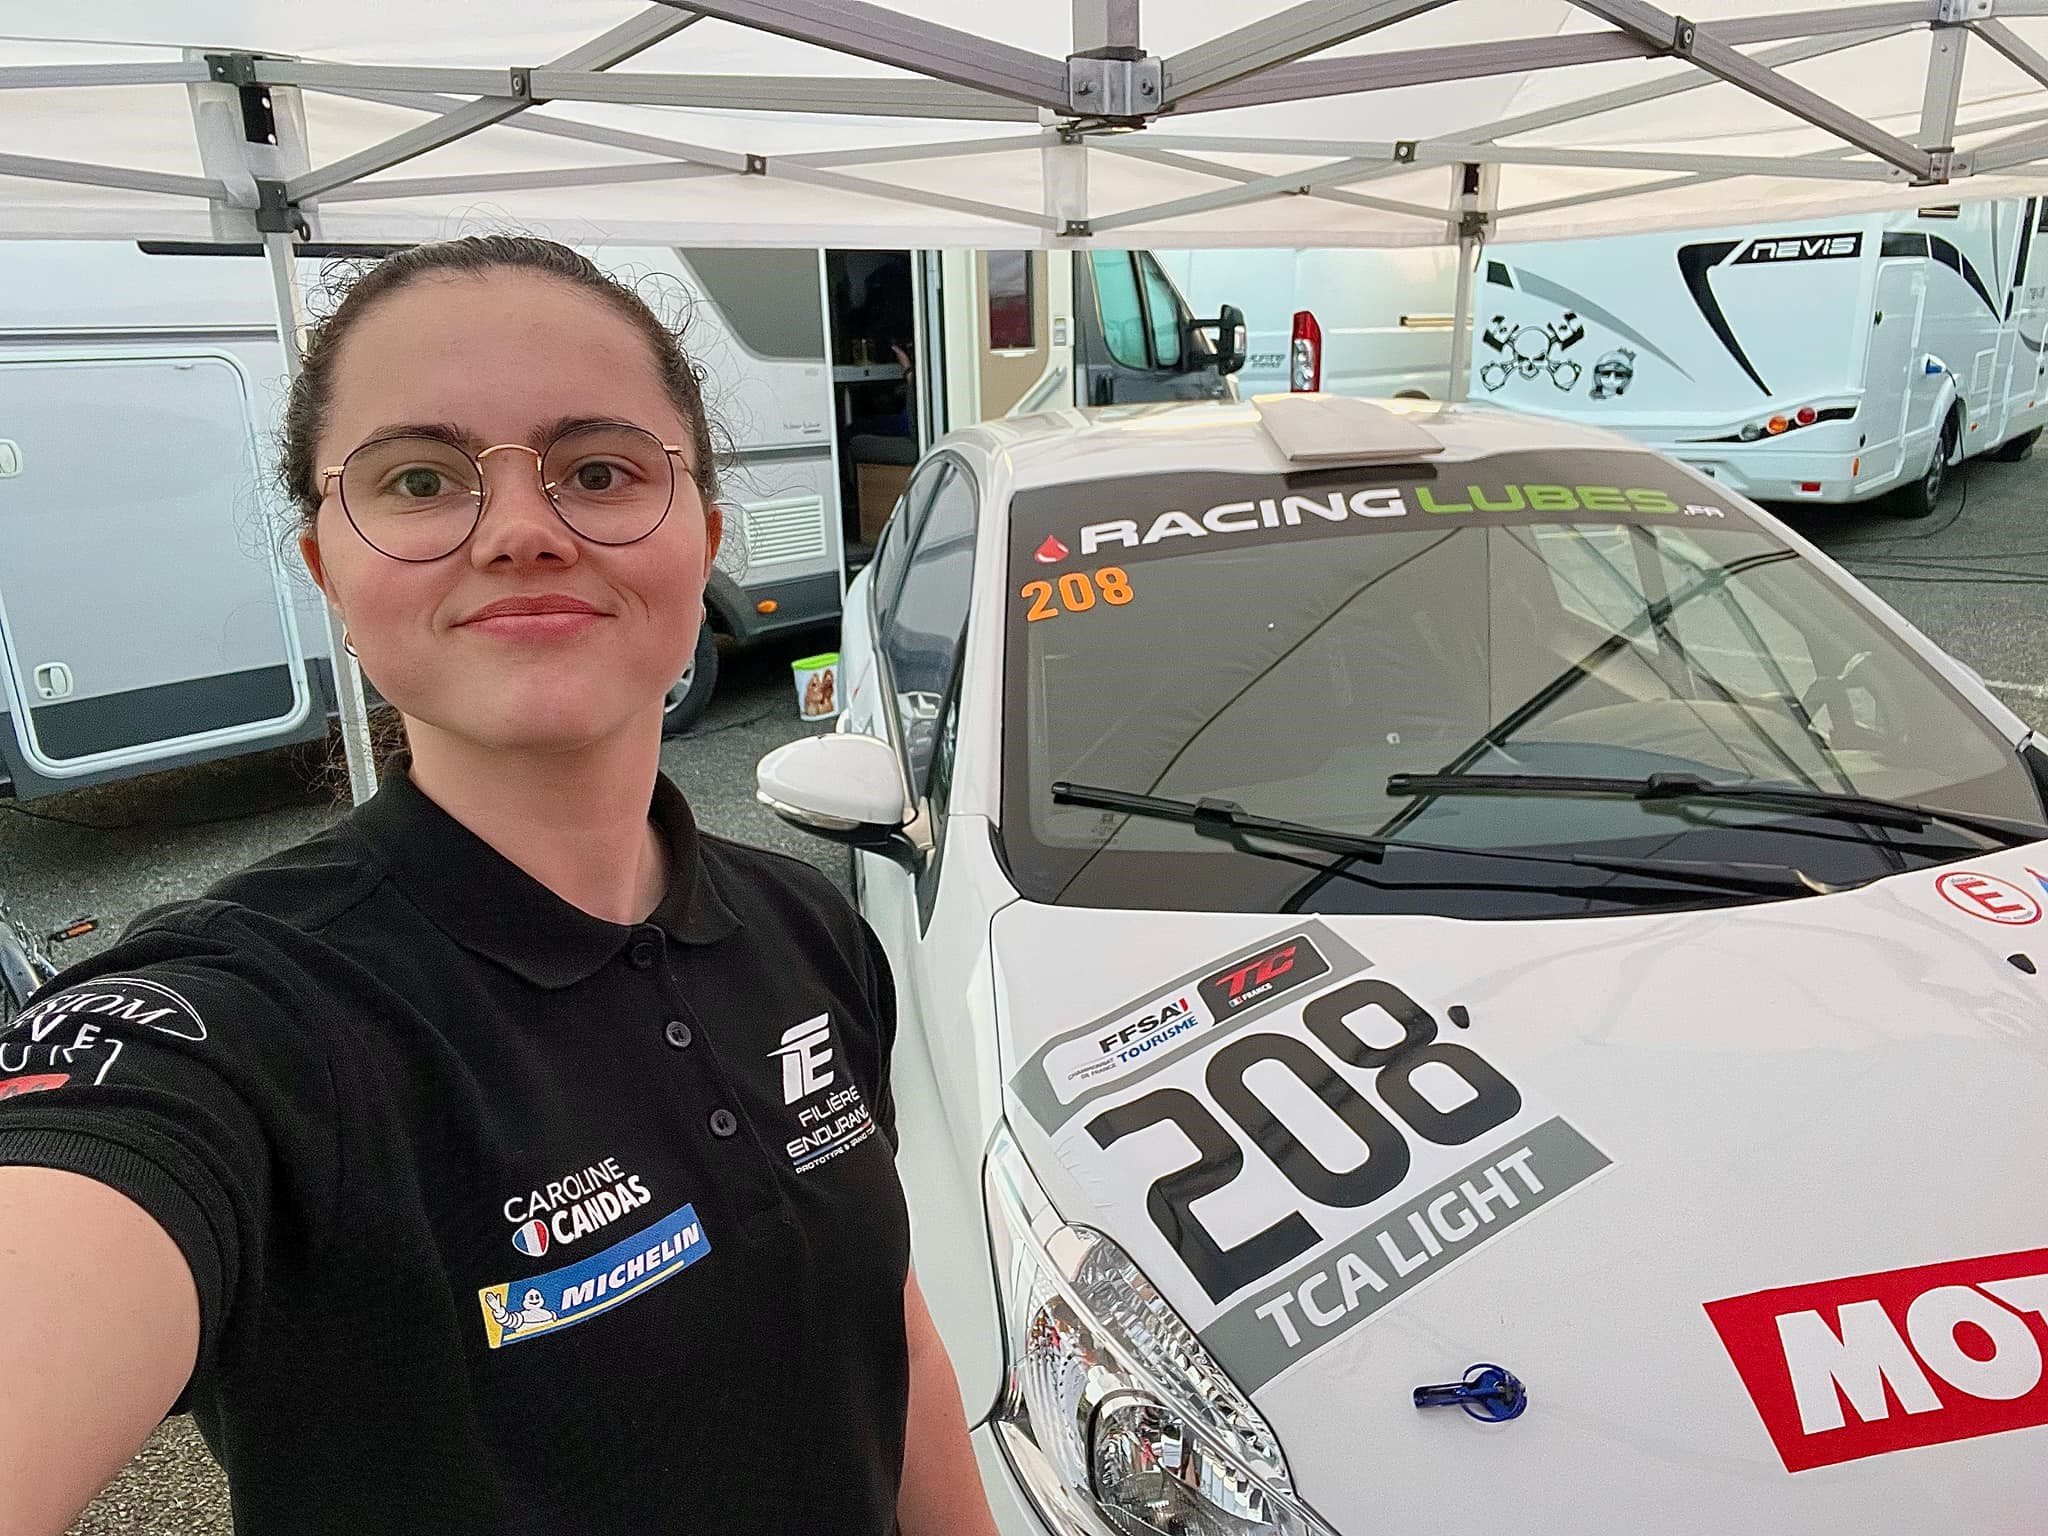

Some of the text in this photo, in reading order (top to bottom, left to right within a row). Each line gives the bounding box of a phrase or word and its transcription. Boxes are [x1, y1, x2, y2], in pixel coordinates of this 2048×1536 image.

[1752, 237, 1856, 259] NEVIS
[1079, 487, 1408, 556] RACING
[1021, 567, 1134, 622] 208
[1215, 946, 1297, 998] TC
[1098, 1003, 1183, 1054] FFSA
[1117, 1016, 1199, 1063] TOURISME
[1084, 979, 1522, 1306] 208
[503, 1157, 626, 1223] CAROLINE
[551, 1174, 651, 1245] CANDAS
[561, 1222, 700, 1310] MICHELIN
[1254, 1146, 1545, 1348] TCA LIGHT
